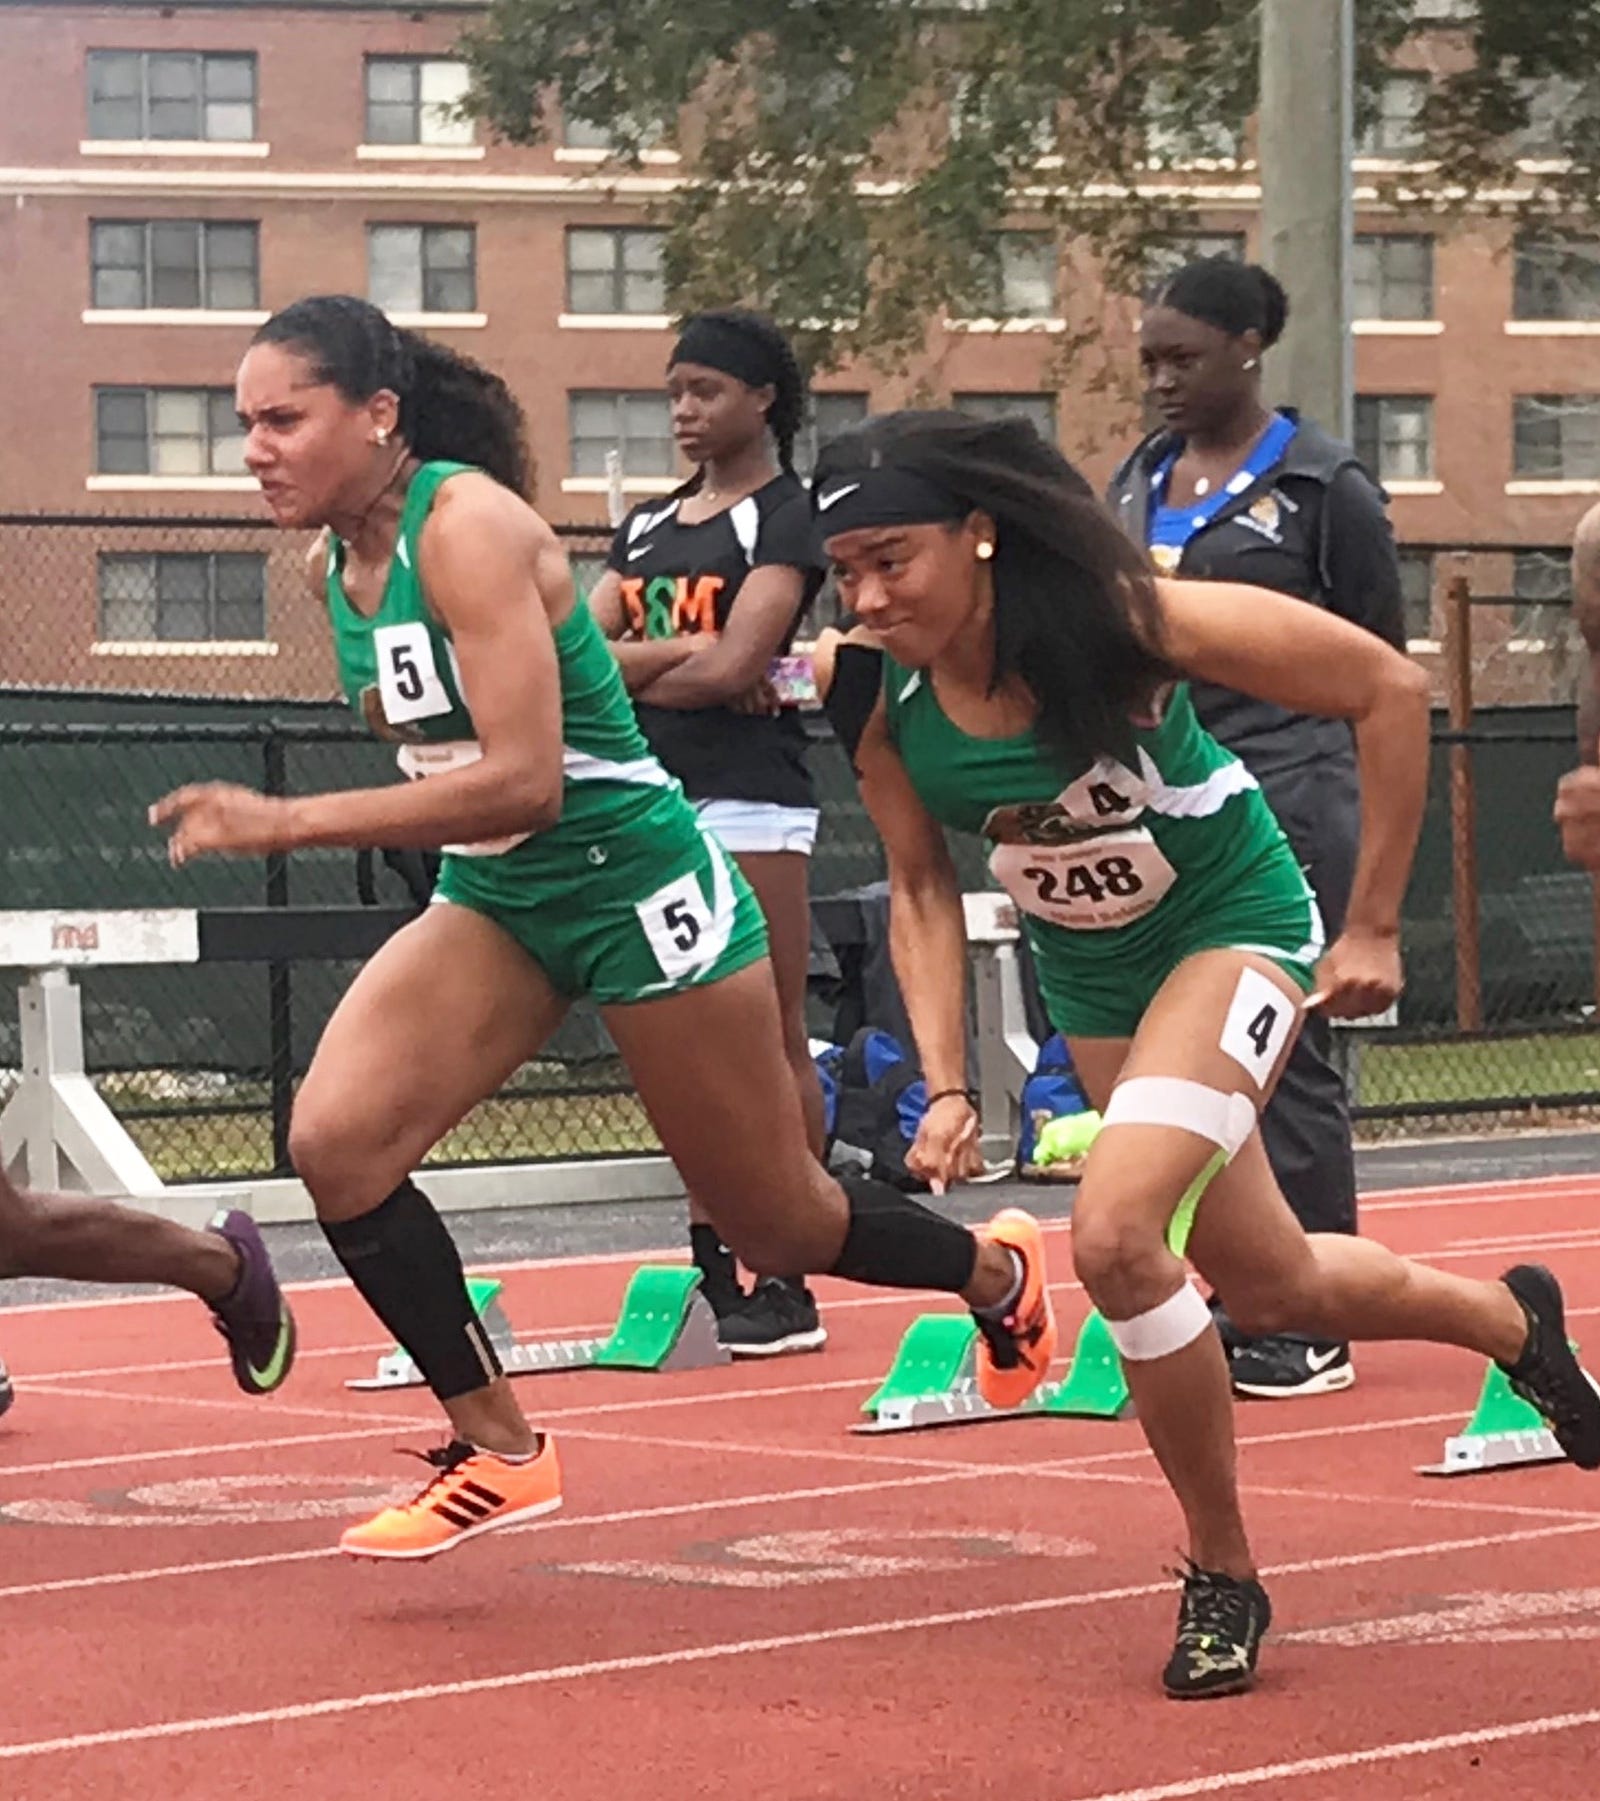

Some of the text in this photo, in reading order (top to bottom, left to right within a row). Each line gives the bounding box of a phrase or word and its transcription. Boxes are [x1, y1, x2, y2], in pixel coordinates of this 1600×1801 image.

[390, 644, 424, 700] 5
[1088, 783, 1131, 815] 4
[1023, 856, 1143, 905] 248
[663, 899, 701, 952] 5
[1247, 1003, 1278, 1057] 4
